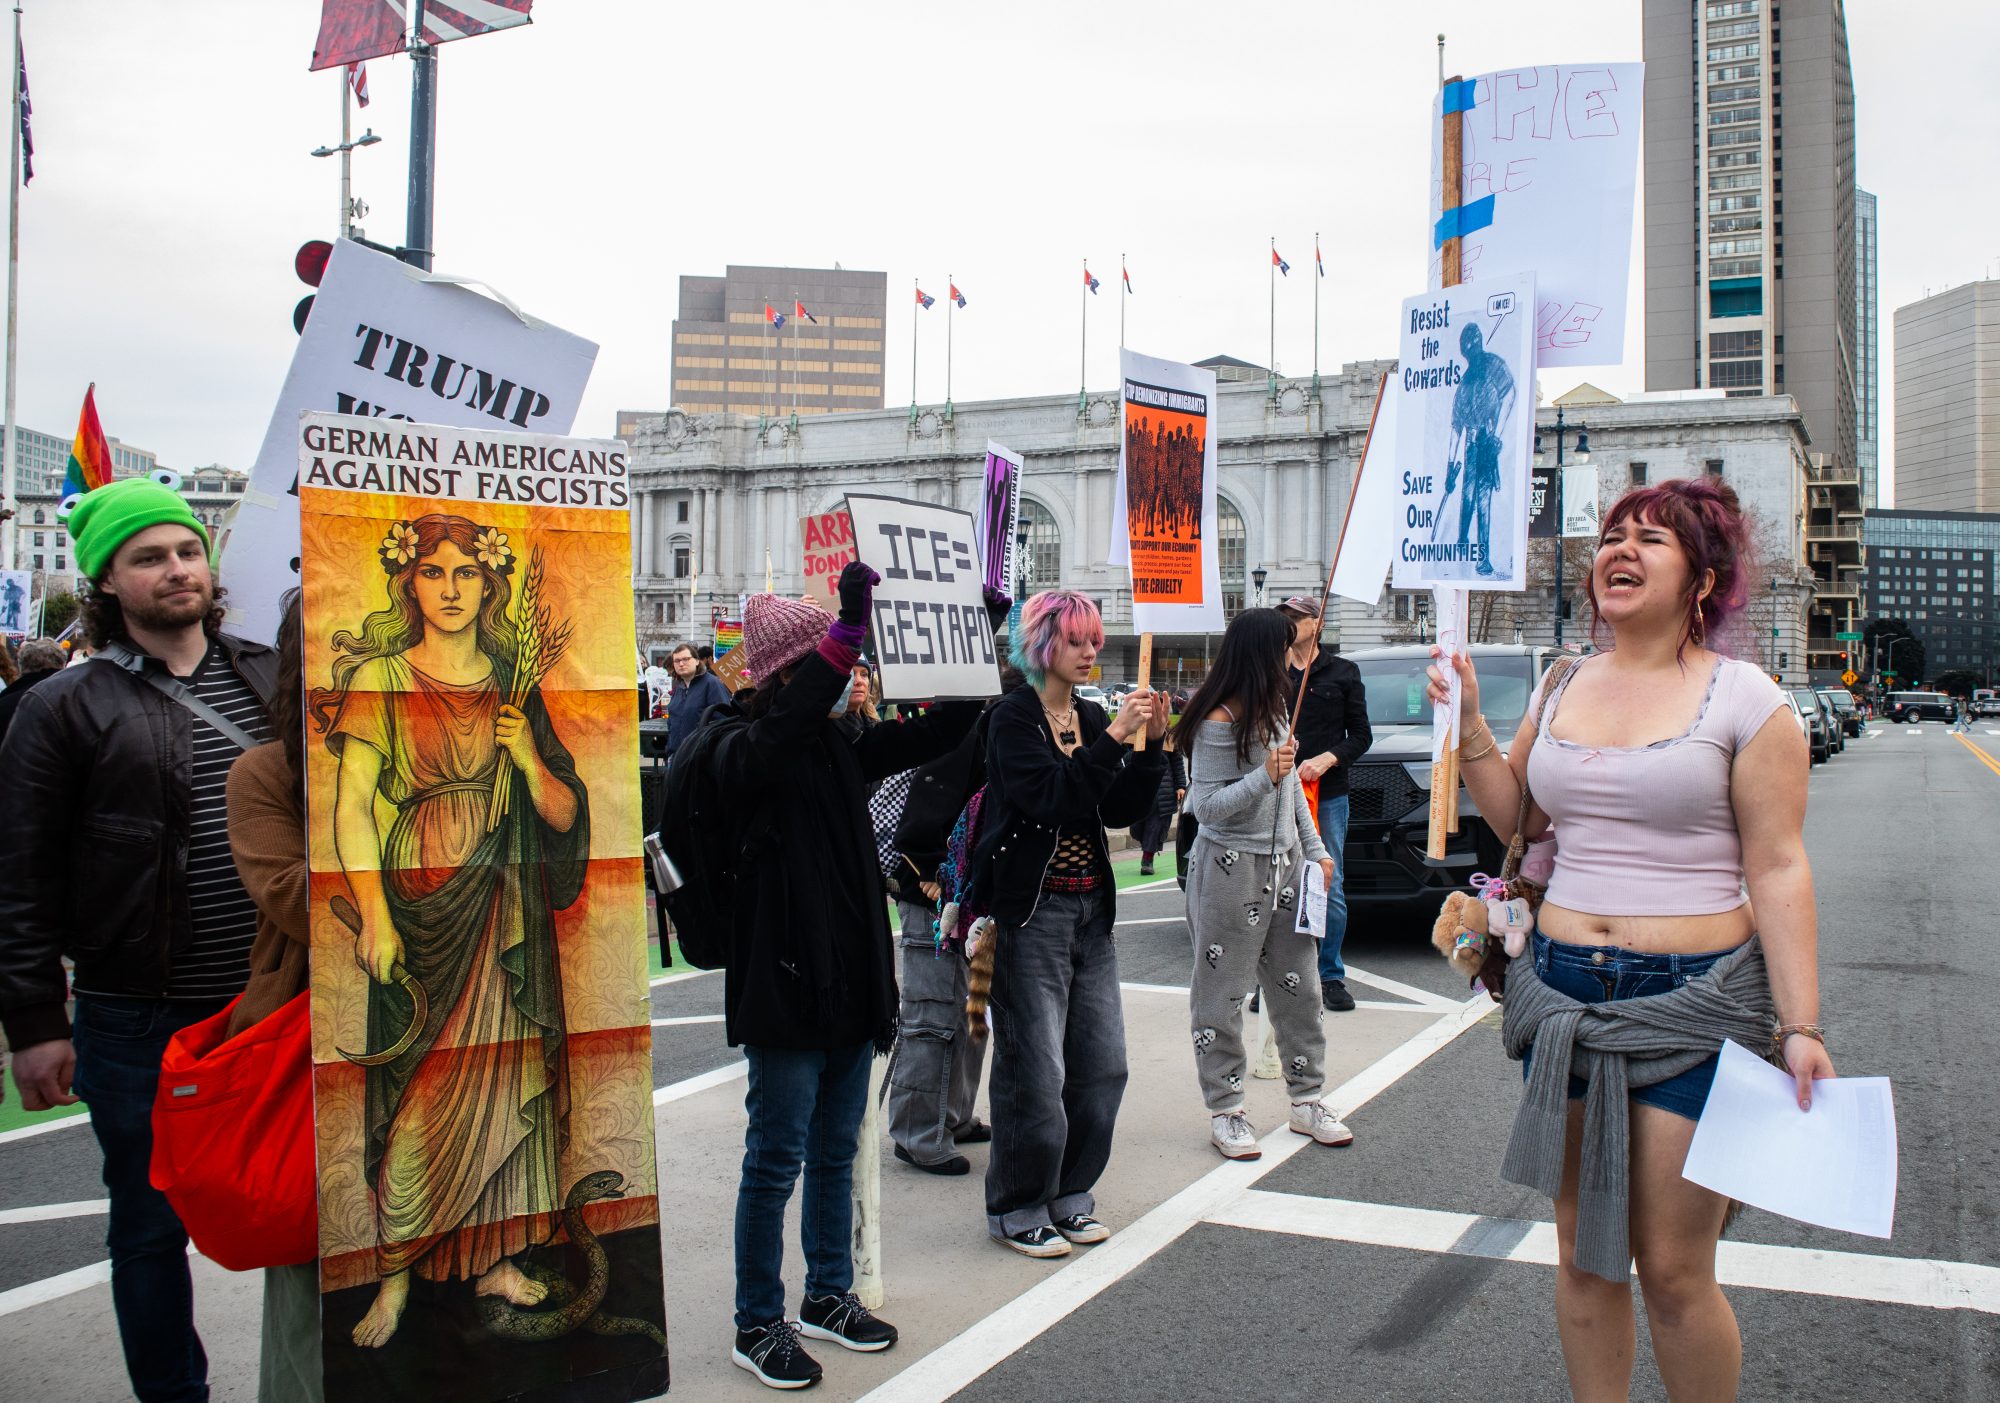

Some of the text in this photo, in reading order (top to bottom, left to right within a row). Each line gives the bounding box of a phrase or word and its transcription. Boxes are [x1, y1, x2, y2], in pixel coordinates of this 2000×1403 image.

[1410, 299, 1450, 335] Resist
[1421, 337, 1439, 361] the
[353, 323, 551, 429] TRUMP
[1404, 359, 1461, 392] Cowards
[1135, 385, 1168, 407] DEMONIZING
[1168, 392, 1205, 413] IMMIGRANTS
[303, 424, 627, 477] GERMAN AMERICANS
[306, 456, 462, 498] AGAINST
[477, 471, 629, 507] FASCISTS
[1402, 470, 1433, 496] SAVE
[1003, 465, 1019, 591] IMMIGRANT JUSTICE
[1406, 503, 1433, 529] OUR
[1141, 540, 1161, 551] SUPPORT
[1161, 541, 1171, 552] OUR
[1172, 542, 1197, 553] ECONOMY
[1401, 537, 1486, 562] COMMUNITIES
[1139, 577, 1149, 593] THE
[1150, 577, 1183, 594] CRUELTY
[873, 599, 996, 665] GESTAPO
